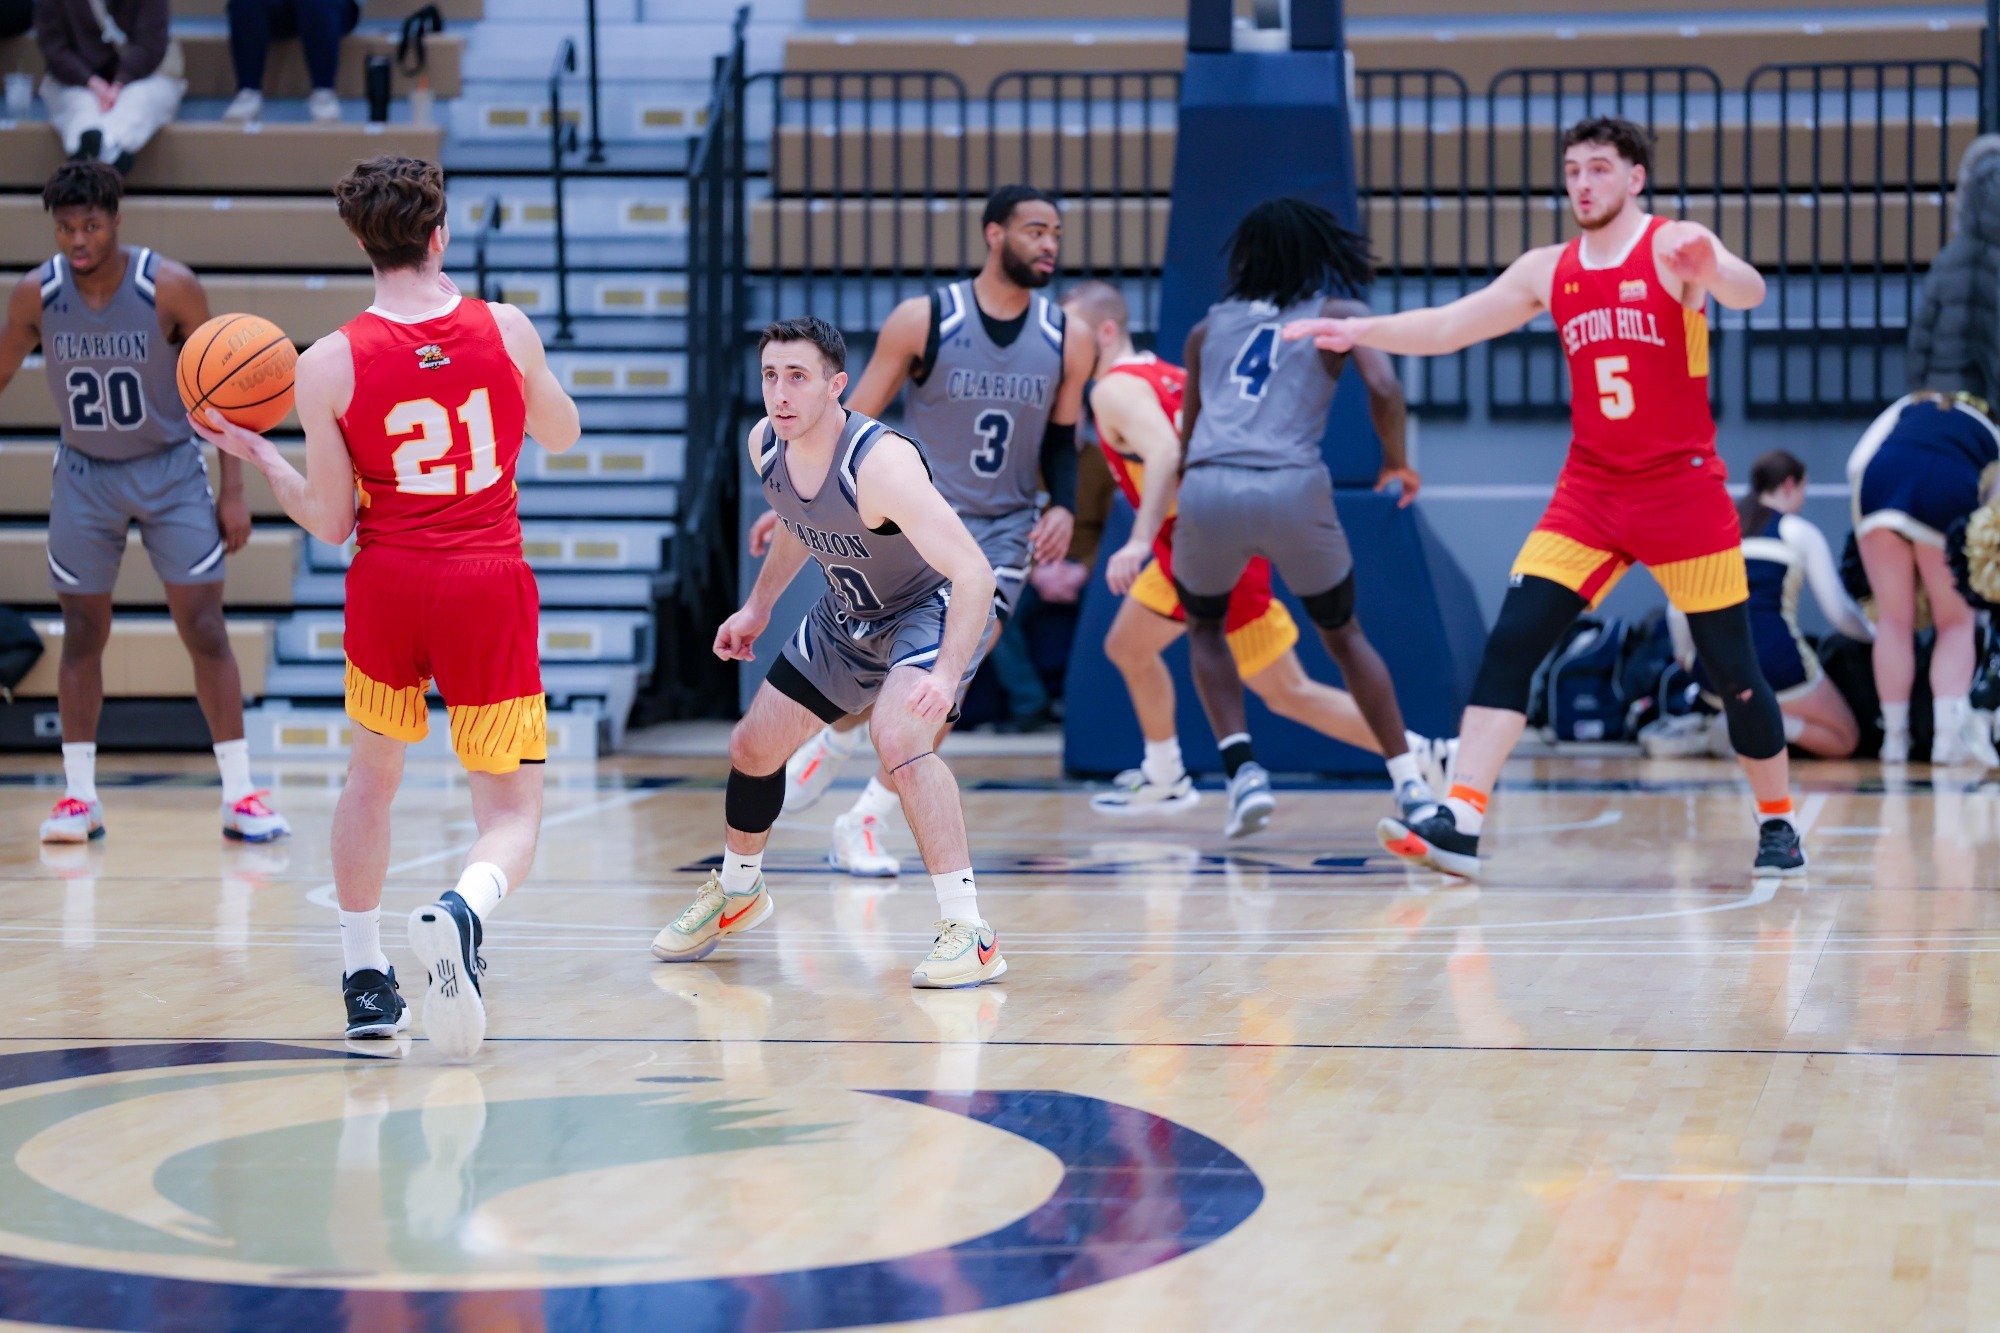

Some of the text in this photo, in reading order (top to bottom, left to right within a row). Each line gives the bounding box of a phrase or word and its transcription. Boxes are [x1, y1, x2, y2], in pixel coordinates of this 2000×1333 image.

[53, 331, 148, 364] CLARION
[1230, 322, 1281, 402] 4
[1562, 307, 1666, 356] SETON HILL
[65, 366, 147, 431] 20
[946, 367, 1051, 410] CLARION
[1594, 354, 1636, 421] 5
[384, 387, 503, 496] 21
[970, 408, 1015, 479] 3
[777, 512, 873, 559] ARION
